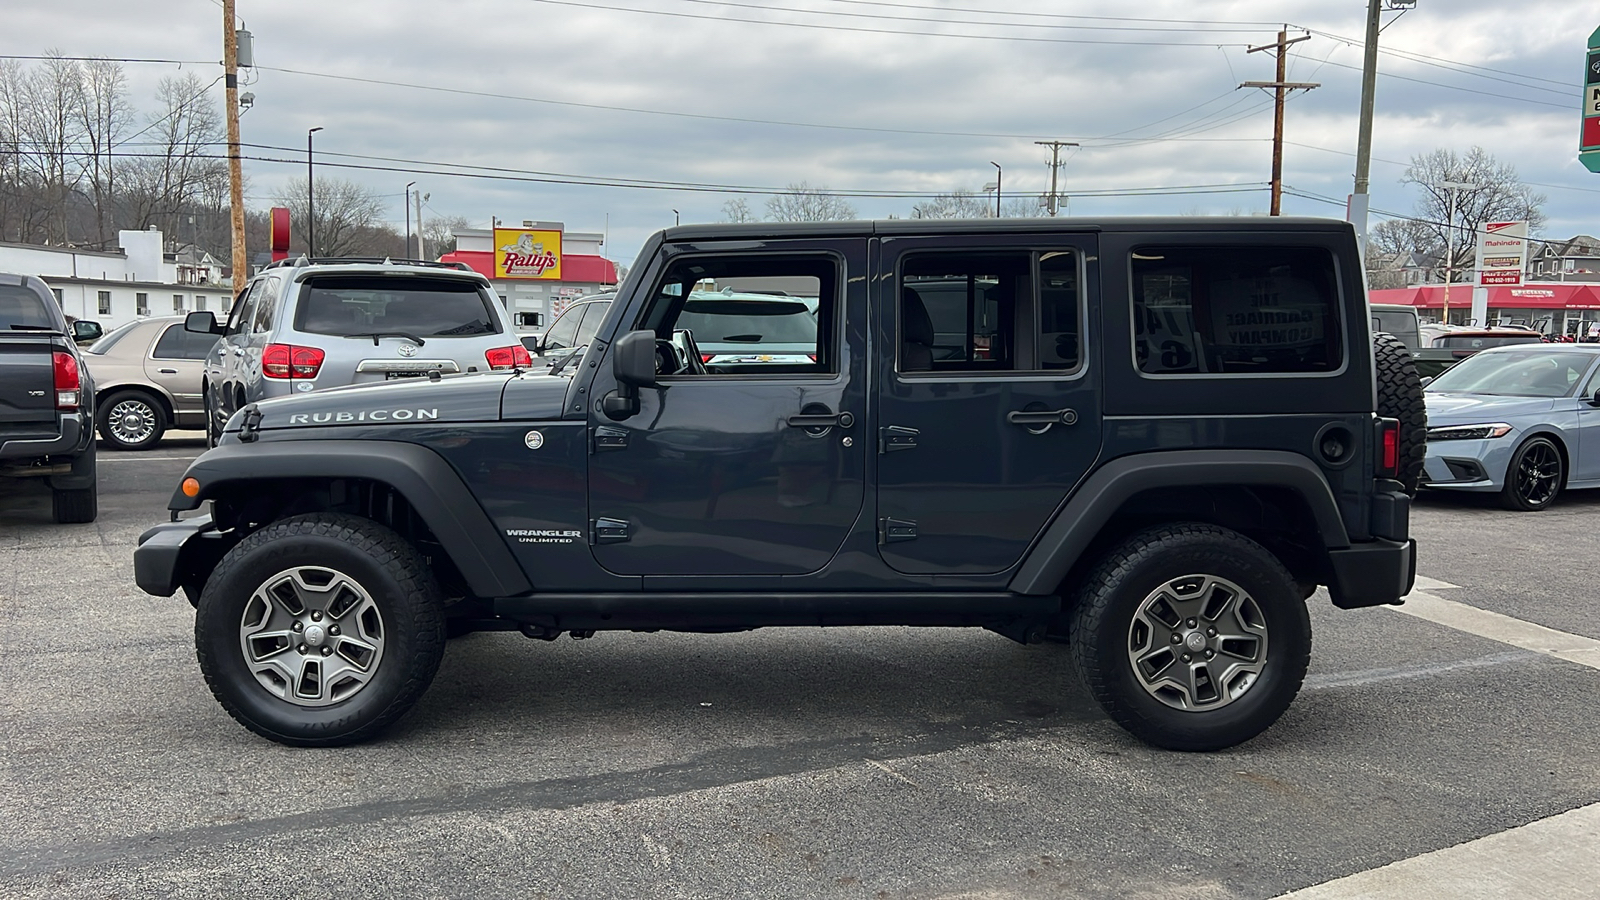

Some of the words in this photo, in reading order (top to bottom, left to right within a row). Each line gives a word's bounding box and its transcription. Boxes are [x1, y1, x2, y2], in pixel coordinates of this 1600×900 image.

[502, 251, 556, 274] Rally's
[289, 408, 438, 424] RUBICON
[506, 529, 581, 538] WRANGLER
